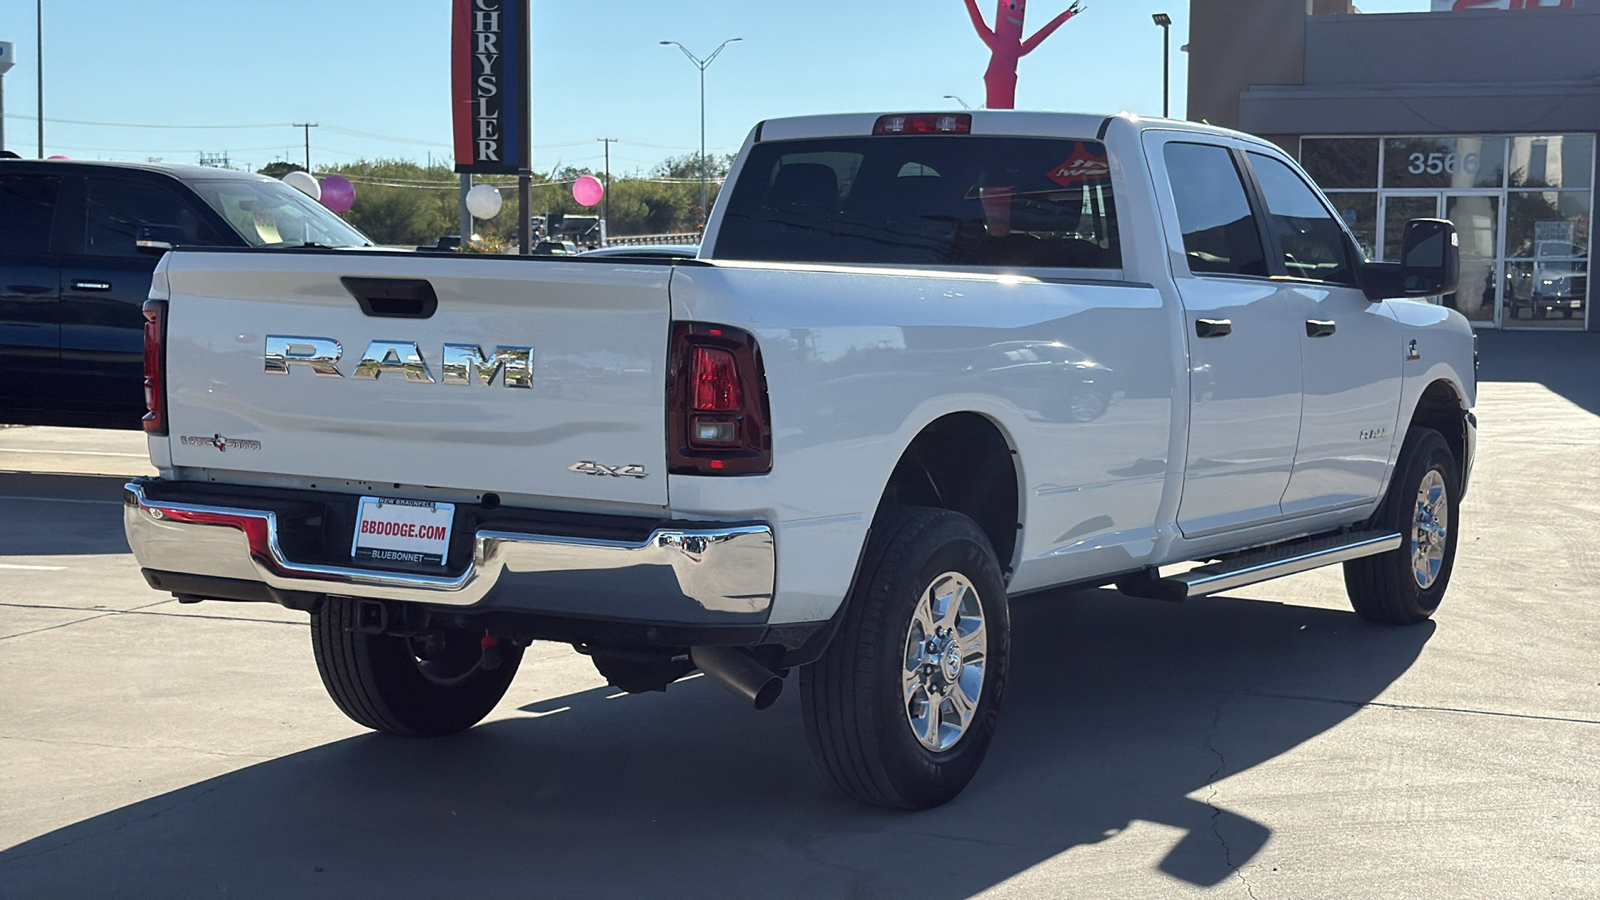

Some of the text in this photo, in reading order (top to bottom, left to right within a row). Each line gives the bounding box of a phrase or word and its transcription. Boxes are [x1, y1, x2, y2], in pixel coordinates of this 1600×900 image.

[1408, 152, 1480, 175] 3566
[264, 334, 535, 389] RAM
[396, 499, 434, 507] BRAUNFELS
[361, 520, 446, 540] BBDODGE.COM
[372, 550, 423, 562] BLUEBONNET
